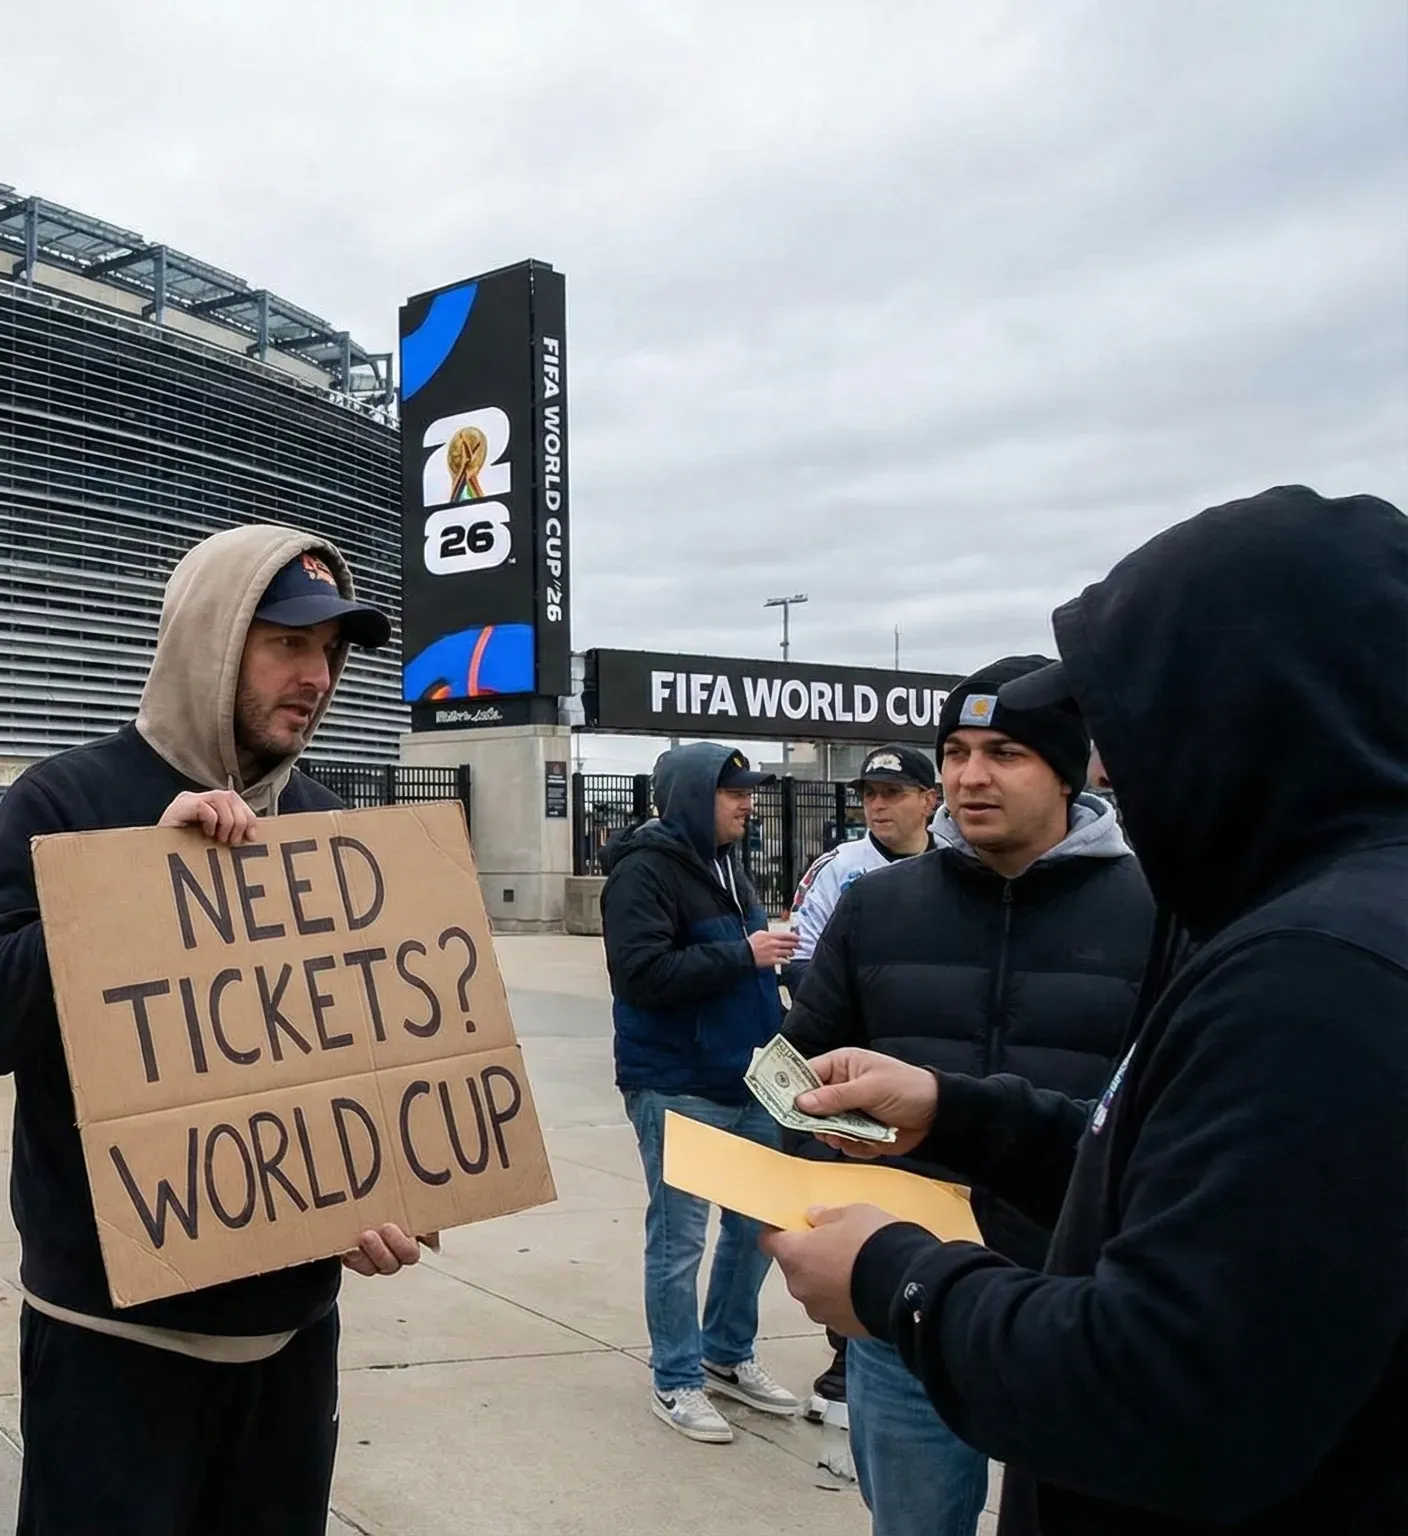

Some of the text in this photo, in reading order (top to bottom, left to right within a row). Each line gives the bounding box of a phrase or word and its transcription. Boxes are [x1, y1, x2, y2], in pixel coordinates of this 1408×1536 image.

[543, 337, 560, 399] FIFA
[544, 405, 561, 512] WORLD
[440, 521, 494, 559] 26
[546, 517, 562, 578] CUP
[651, 670, 738, 716] FIFA
[742, 676, 878, 723] WORLD
[167, 836, 385, 950] NEED
[102, 926, 478, 1083] TICKETS?
[109, 1065, 521, 1250] WORLD CUP
